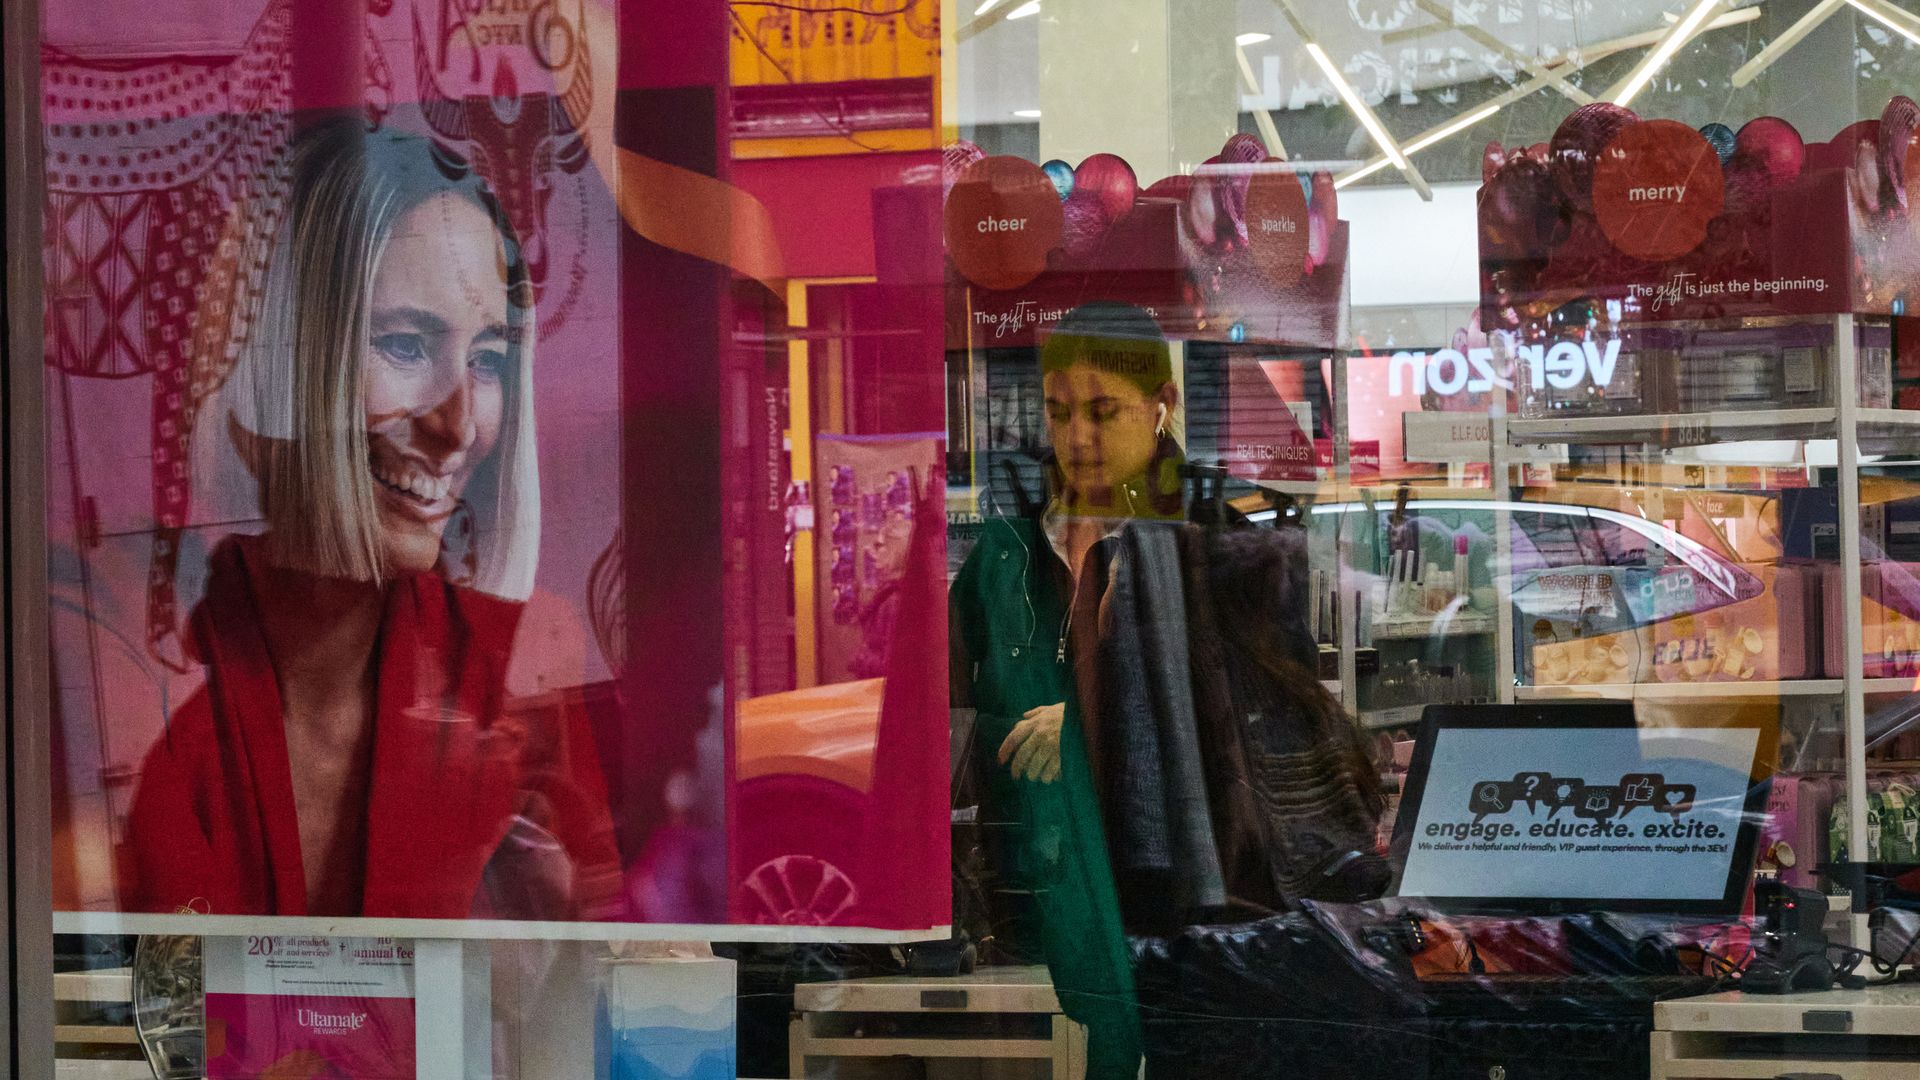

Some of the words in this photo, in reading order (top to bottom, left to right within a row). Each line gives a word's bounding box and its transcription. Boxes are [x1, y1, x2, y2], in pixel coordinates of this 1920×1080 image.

[1628, 184, 1687, 204] merry
[976, 214, 1028, 234] cheer
[1260, 215, 1297, 236] sparkle
[1626, 283, 1653, 298] The
[1652, 271, 1696, 312] gift
[1685, 280, 1696, 294] is
[1697, 278, 1725, 298] just
[1727, 278, 1751, 293] the
[1753, 275, 1830, 293] beginning.
[973, 311, 998, 324] The
[995, 301, 1037, 338] gift
[1026, 309, 1037, 322] is
[1038, 308, 1063, 324] just
[1451, 425, 1473, 441] E.L.F.
[1236, 444, 1256, 459] REAL
[1256, 445, 1309, 462] TECHNIQUES
[1537, 573, 1613, 591] WORLD
[1425, 822, 1521, 841] engage.
[1528, 818, 1635, 838] educate.
[1643, 818, 1727, 838] excite.
[1418, 843, 1433, 851] We
[1434, 842, 1464, 851] deliver
[1472, 843, 1502, 853] helpful
[1503, 843, 1520, 851] and
[1575, 844, 1600, 853] guest
[1601, 844, 1653, 853] experience,
[1655, 843, 1691, 854] through
[1692, 844, 1706, 852] the
[286, 937, 297, 946] all
[354, 947, 393, 959] annual
[395, 946, 414, 959] fee
[297, 1008, 367, 1031] Ultamate
[313, 1027, 347, 1036] REWARDS
